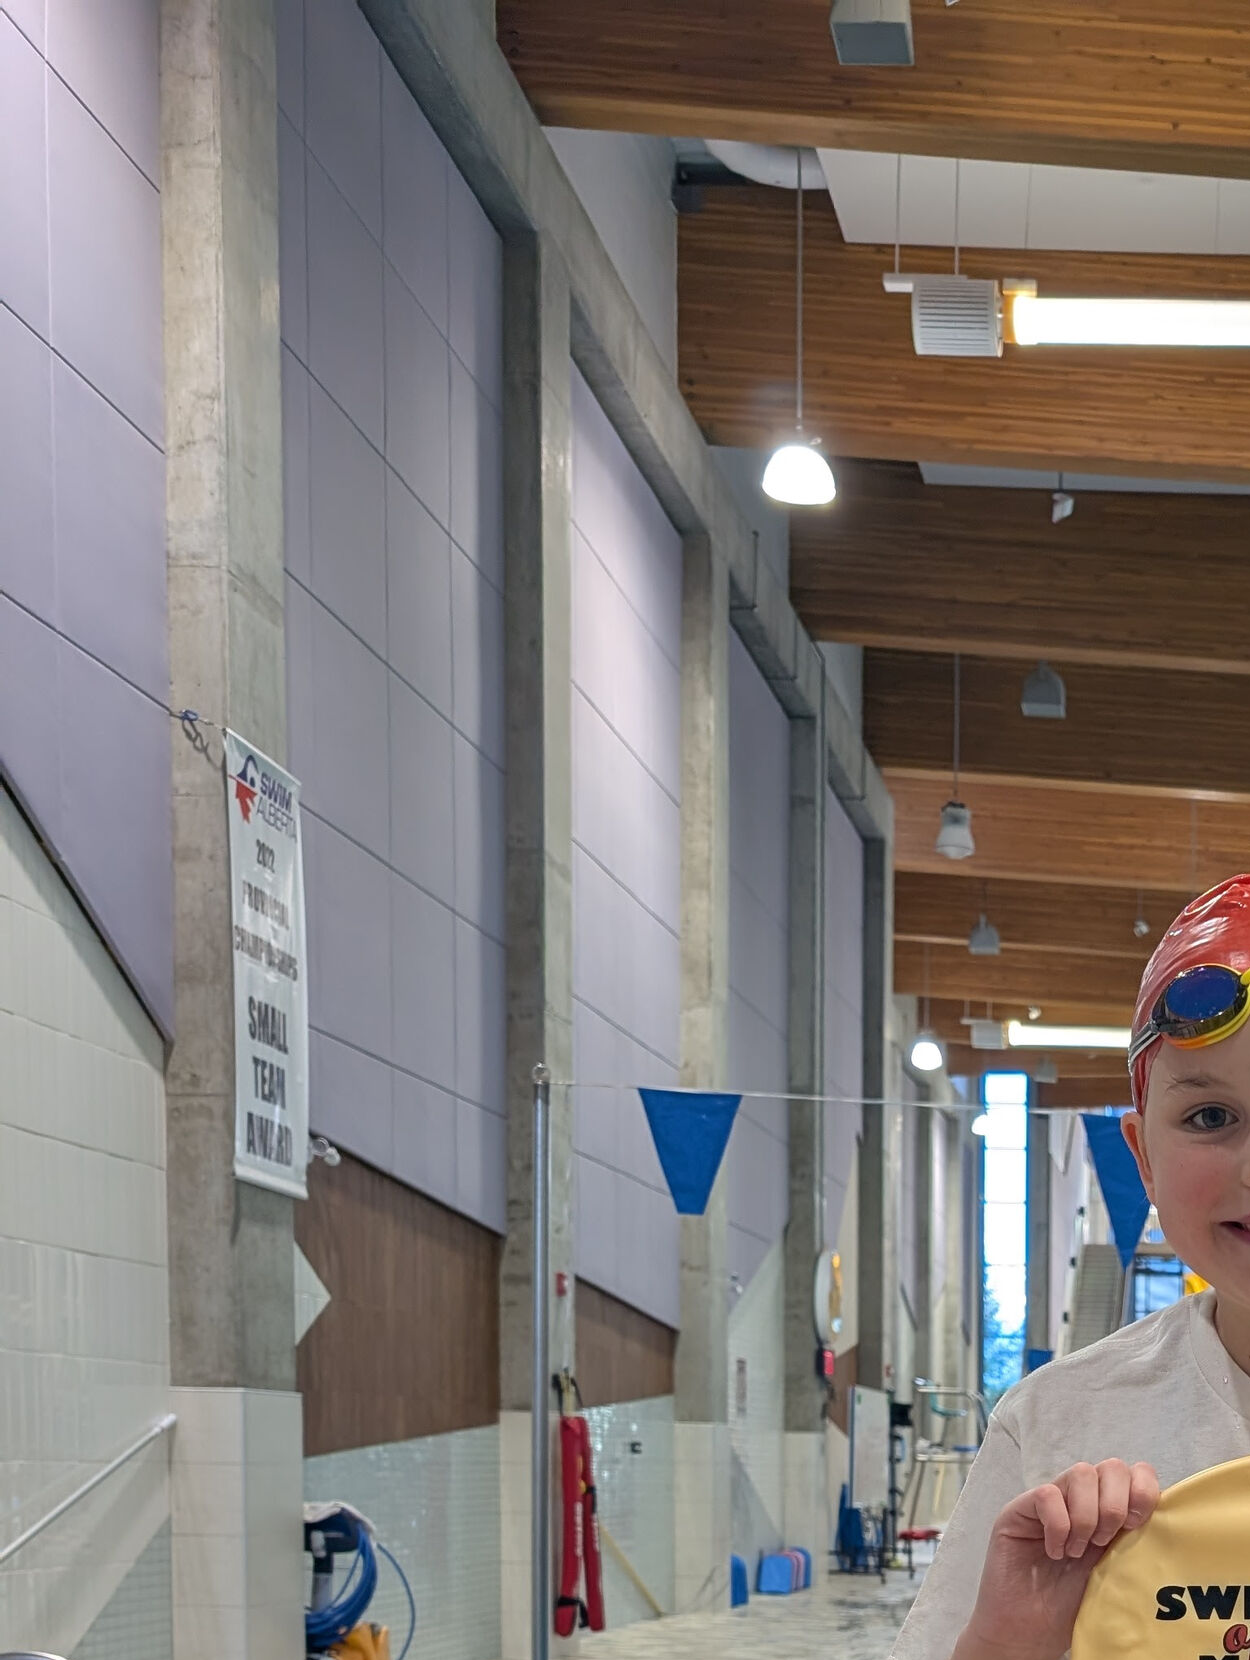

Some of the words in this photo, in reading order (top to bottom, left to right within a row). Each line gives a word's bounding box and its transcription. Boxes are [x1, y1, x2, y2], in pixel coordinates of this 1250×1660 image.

[257, 796, 298, 843] ALBERTA
[261, 771, 292, 814] SWIM
[248, 995, 289, 1056] SMALL
[252, 1055, 287, 1110] TEAM
[246, 1111, 293, 1168] AWARD
